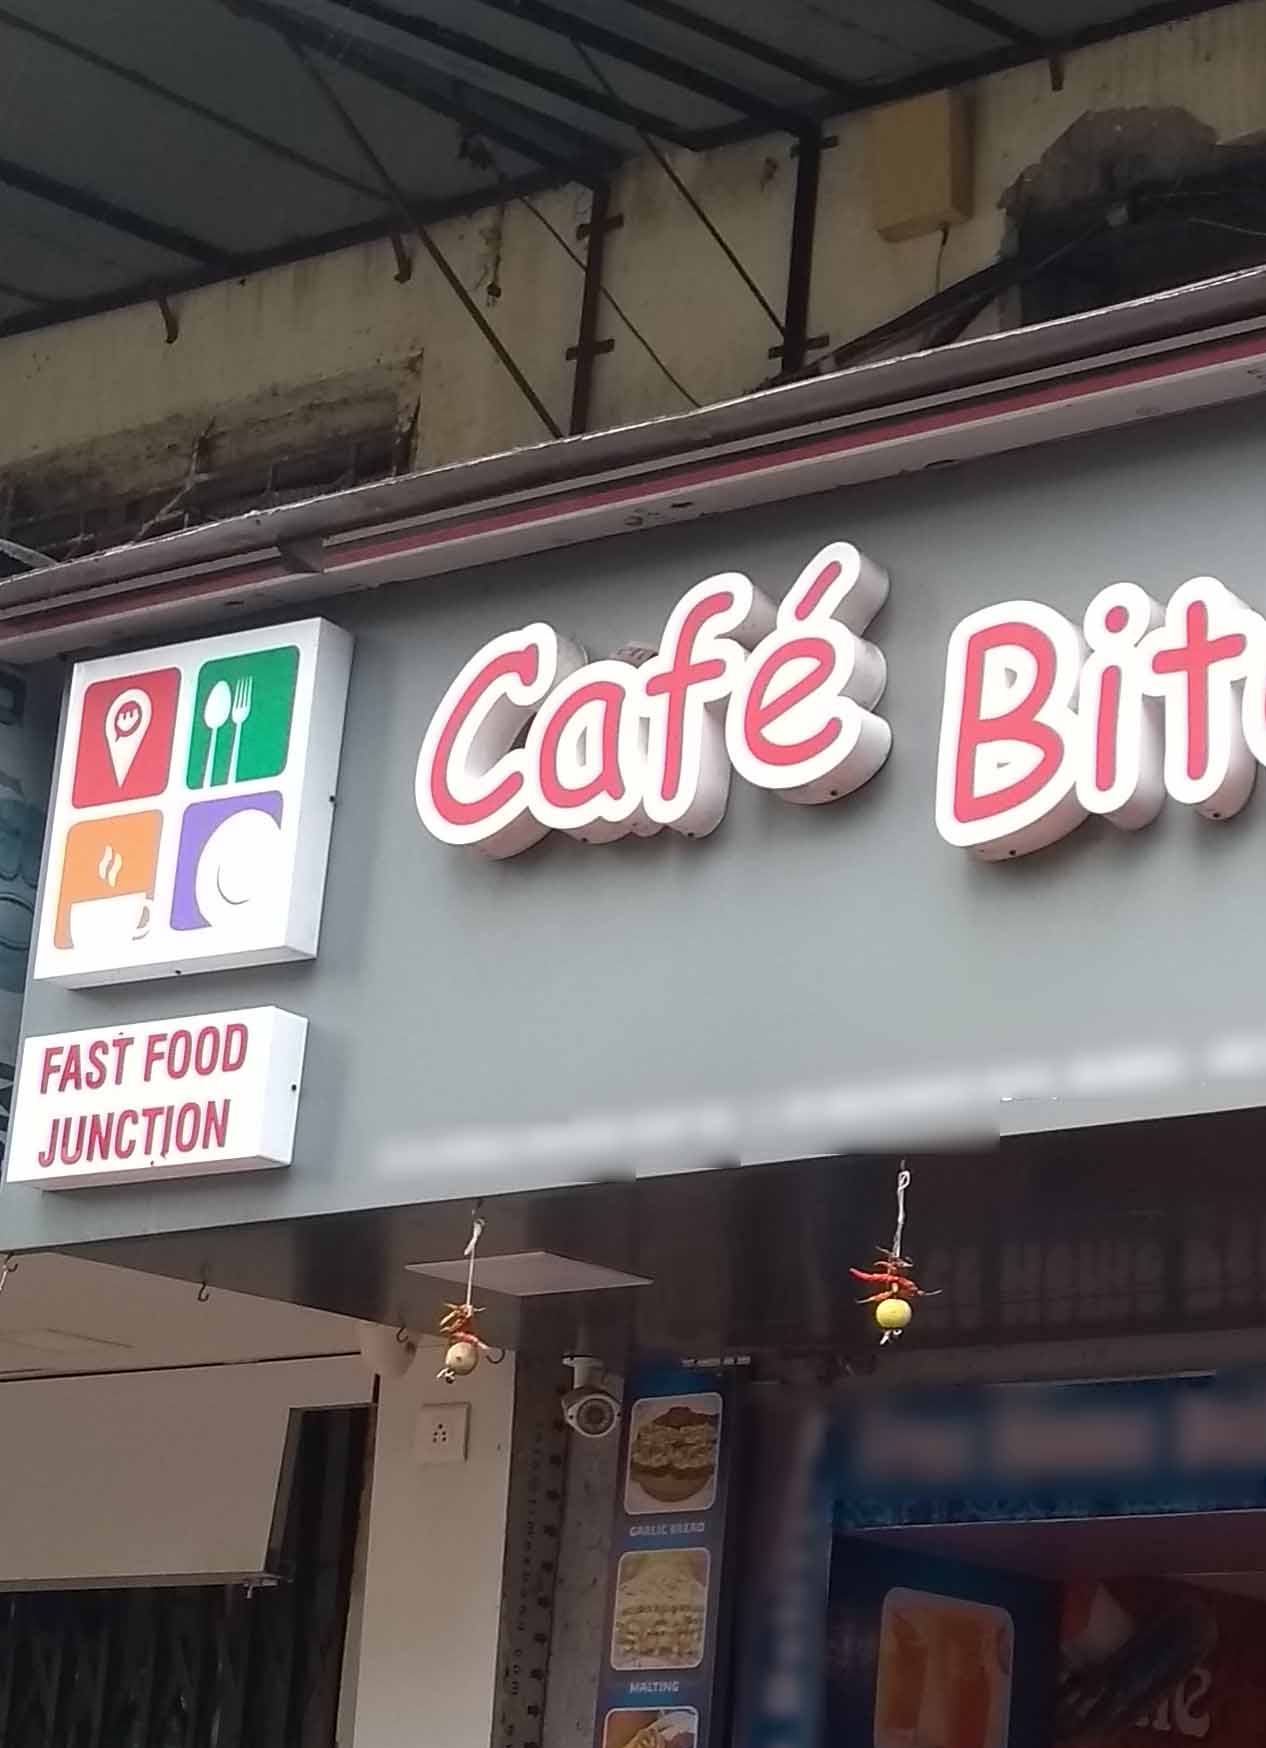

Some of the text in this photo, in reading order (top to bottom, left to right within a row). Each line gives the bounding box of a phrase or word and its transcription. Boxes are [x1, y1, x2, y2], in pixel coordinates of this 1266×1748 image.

[428, 561, 841, 827] Café
[39, 1022, 249, 1095] FAST FOOD
[37, 1098, 231, 1167] JUNCTION
